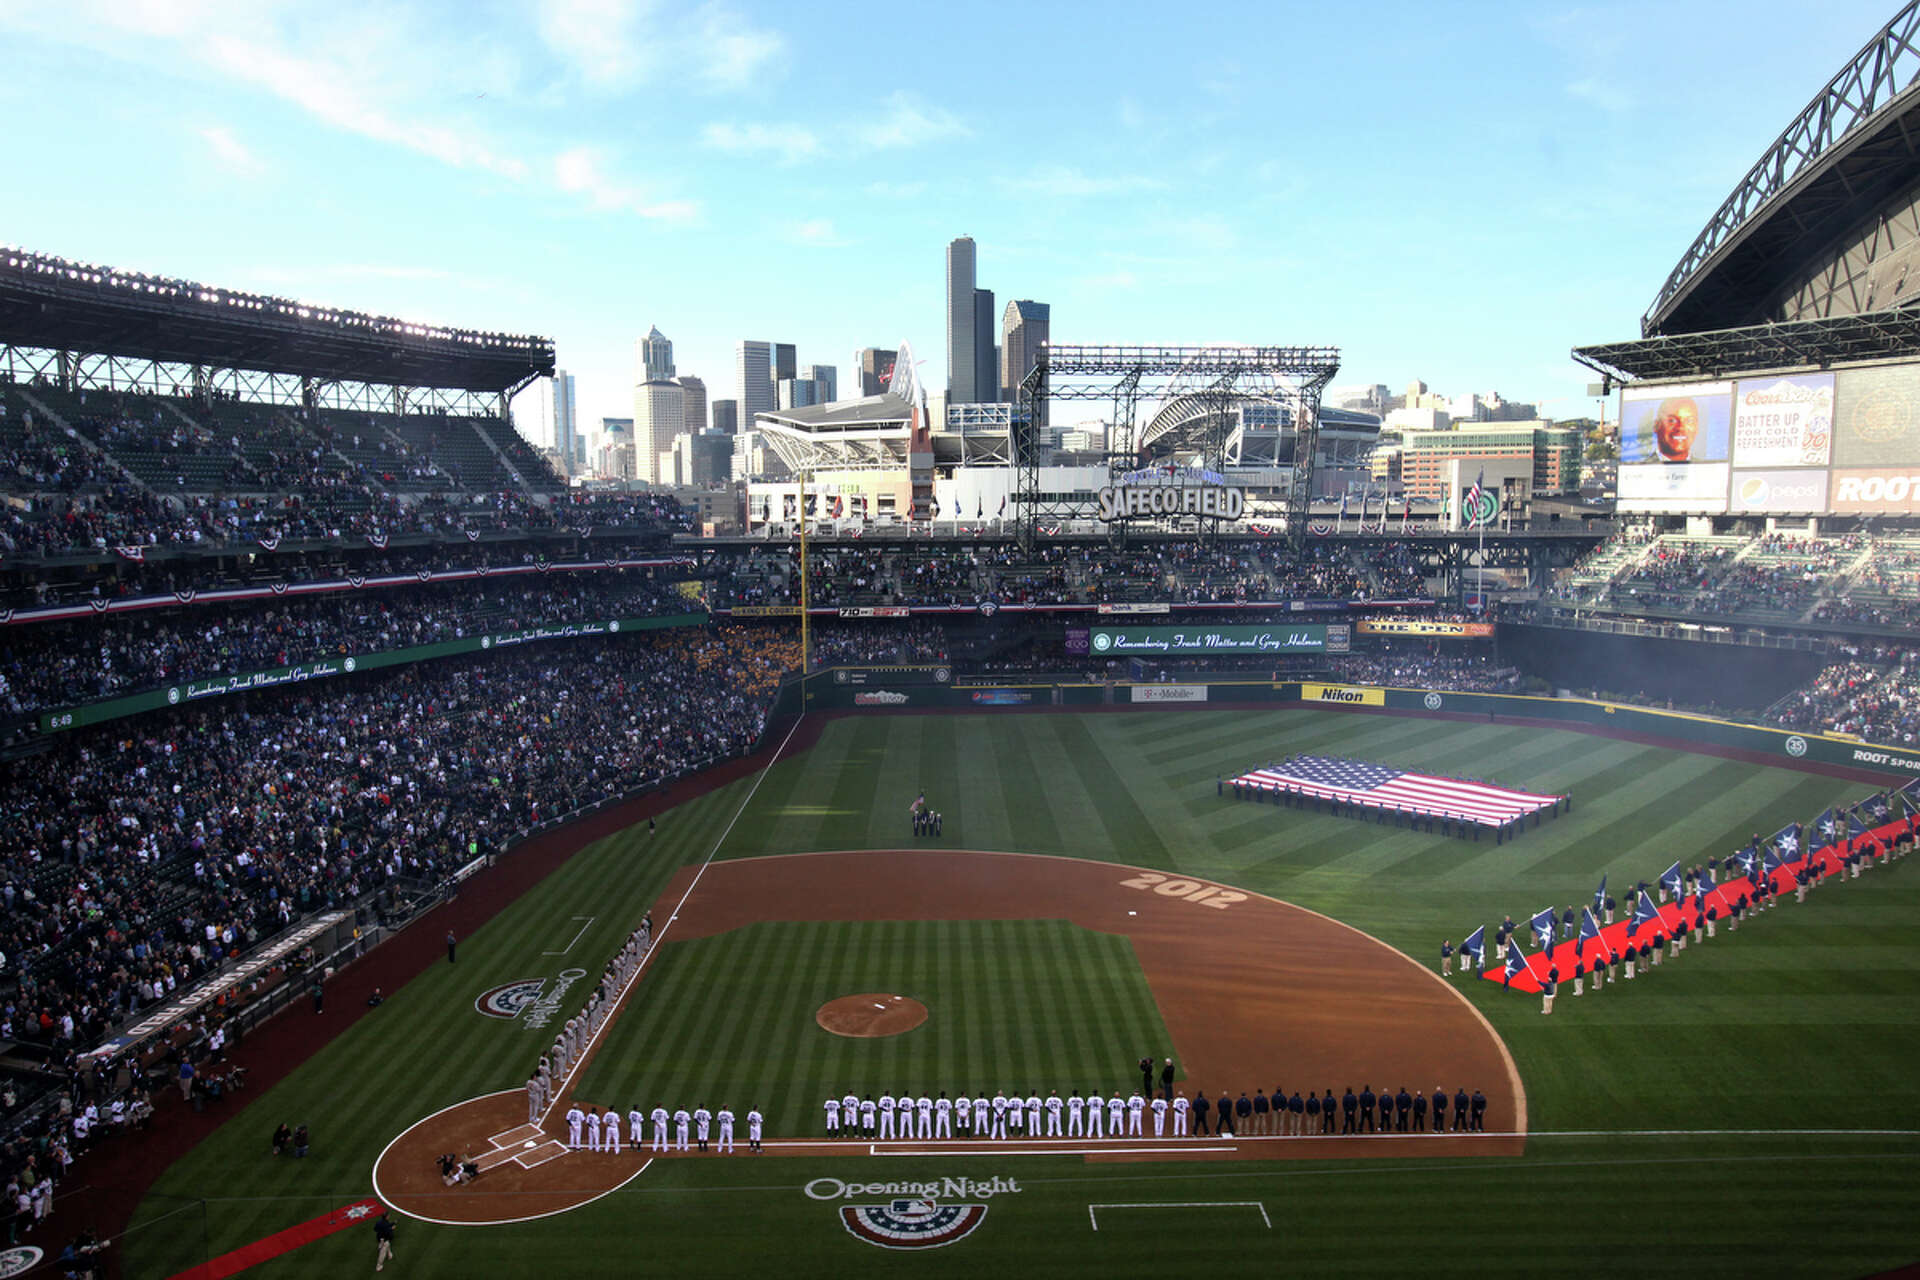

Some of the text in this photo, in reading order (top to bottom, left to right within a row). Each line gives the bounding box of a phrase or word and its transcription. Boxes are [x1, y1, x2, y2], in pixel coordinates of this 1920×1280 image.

[1738, 414, 1780, 428] BATTER
[1784, 412, 1800, 426] UP
[1766, 427, 1799, 435] COLD
[1771, 484, 1818, 500] pepsi
[1100, 486, 1244, 521] SAFECO FIELD
[841, 607, 860, 617] 710
[1366, 623, 1409, 632] THE
[1113, 635, 1169, 650] Remembering
[1172, 635, 1201, 648] Frank
[1239, 634, 1258, 647] and
[1259, 633, 1280, 650] Greg
[1321, 688, 1364, 702] Nikon
[1853, 749, 1890, 764] ROOT
[1119, 873, 1248, 909] 2012
[127, 1007, 187, 1035] FIELD
[804, 1175, 1022, 1200] Opening Night
